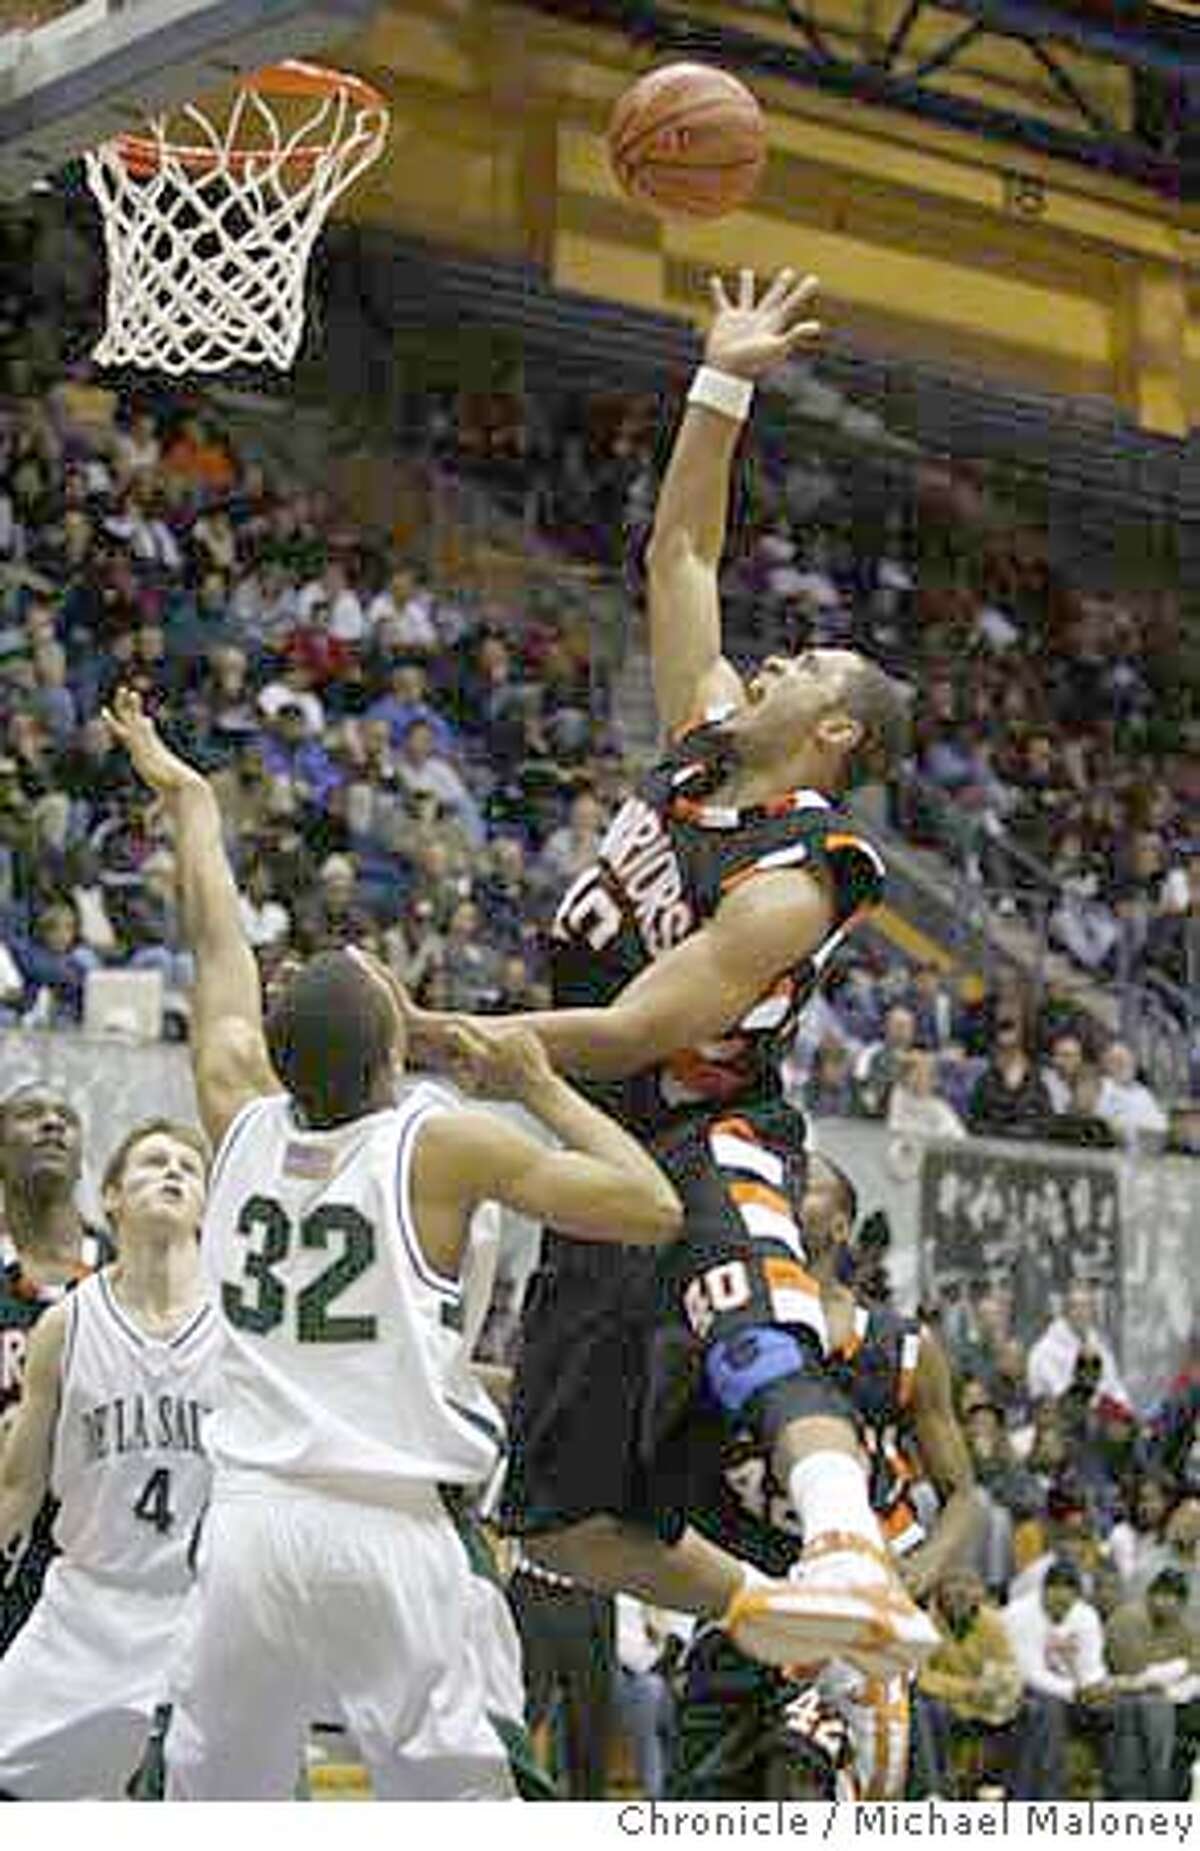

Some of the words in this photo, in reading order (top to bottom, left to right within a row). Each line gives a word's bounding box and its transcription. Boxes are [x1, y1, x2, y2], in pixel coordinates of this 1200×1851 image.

[221, 1194, 377, 1343] 32
[157, 1395, 213, 1455] SAL
[133, 1468, 174, 1534] 4
